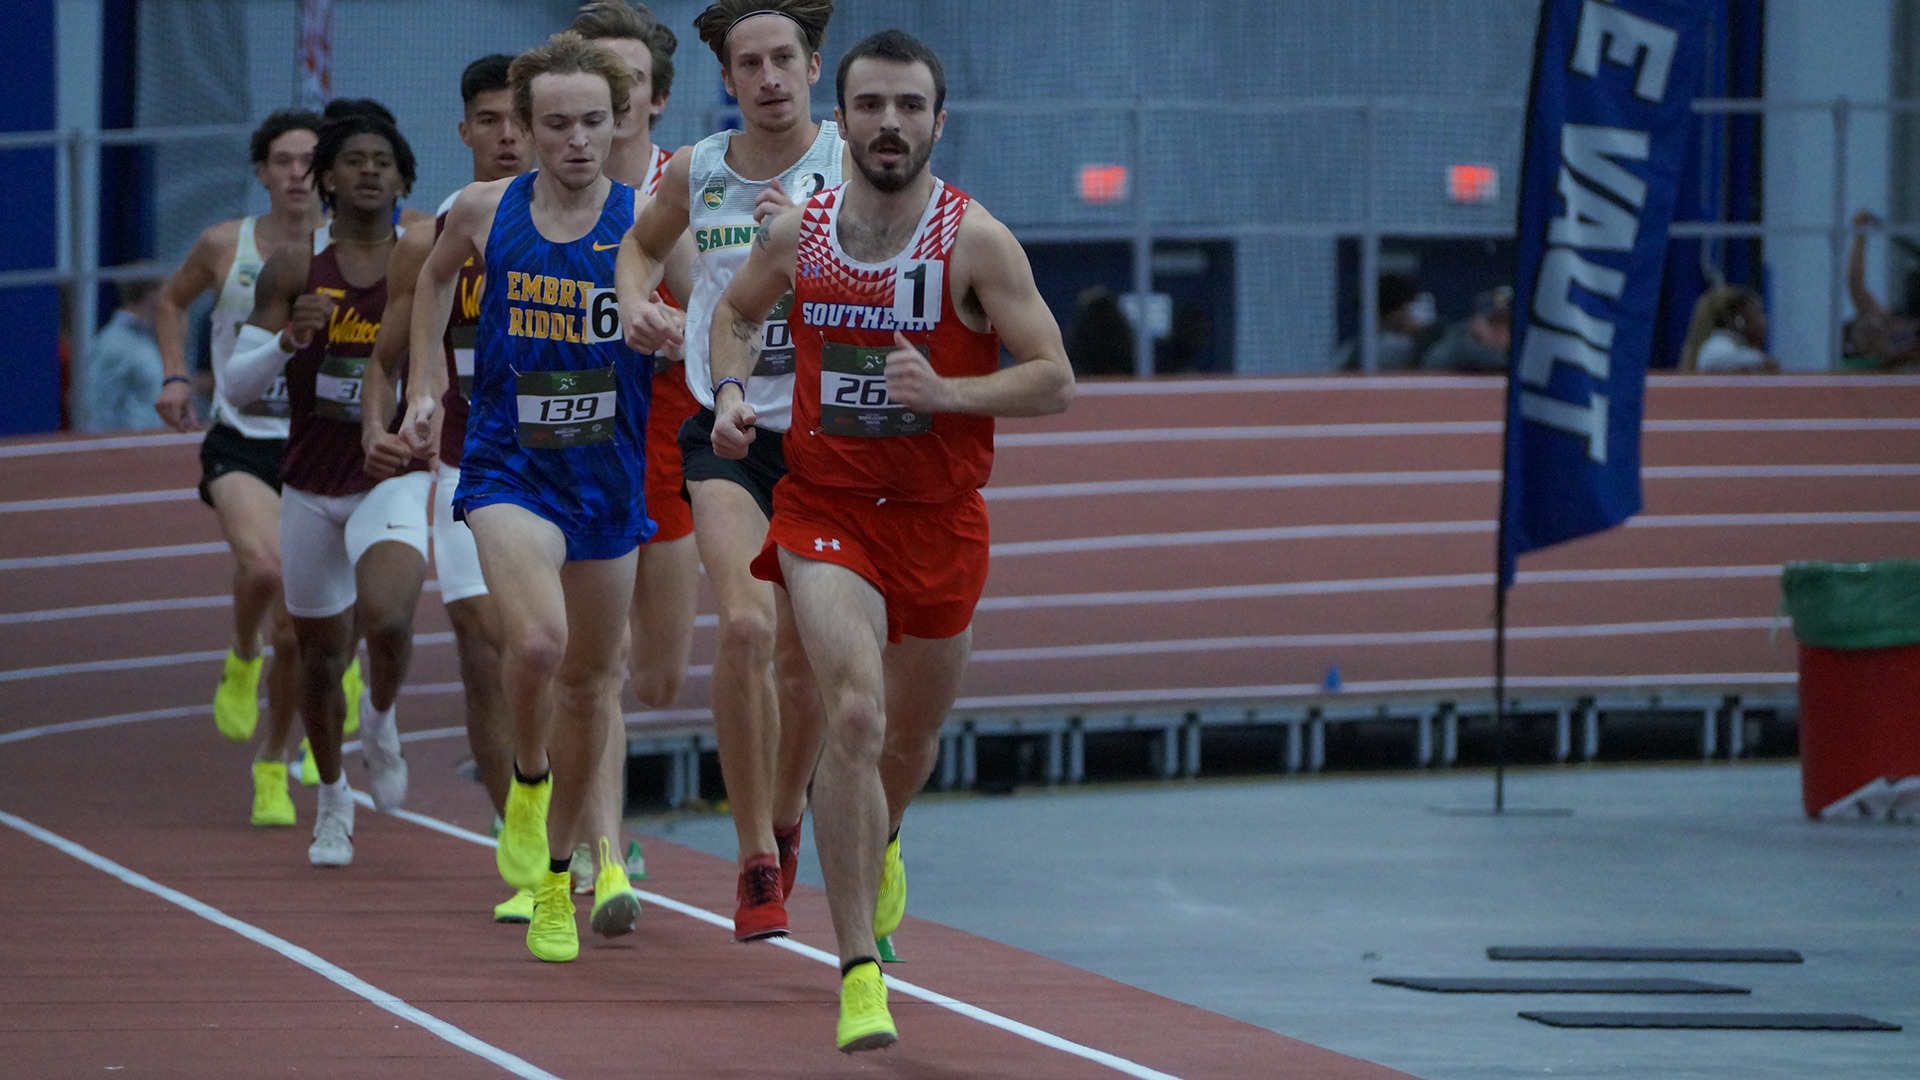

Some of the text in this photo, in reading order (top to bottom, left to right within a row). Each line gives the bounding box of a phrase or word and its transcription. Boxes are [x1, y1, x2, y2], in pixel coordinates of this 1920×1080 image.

[695, 226, 758, 253] SAIN
[904, 263, 927, 318] 1
[1518, 122, 1651, 464] VAULT
[592, 291, 621, 338] 6
[540, 396, 599, 422] 139
